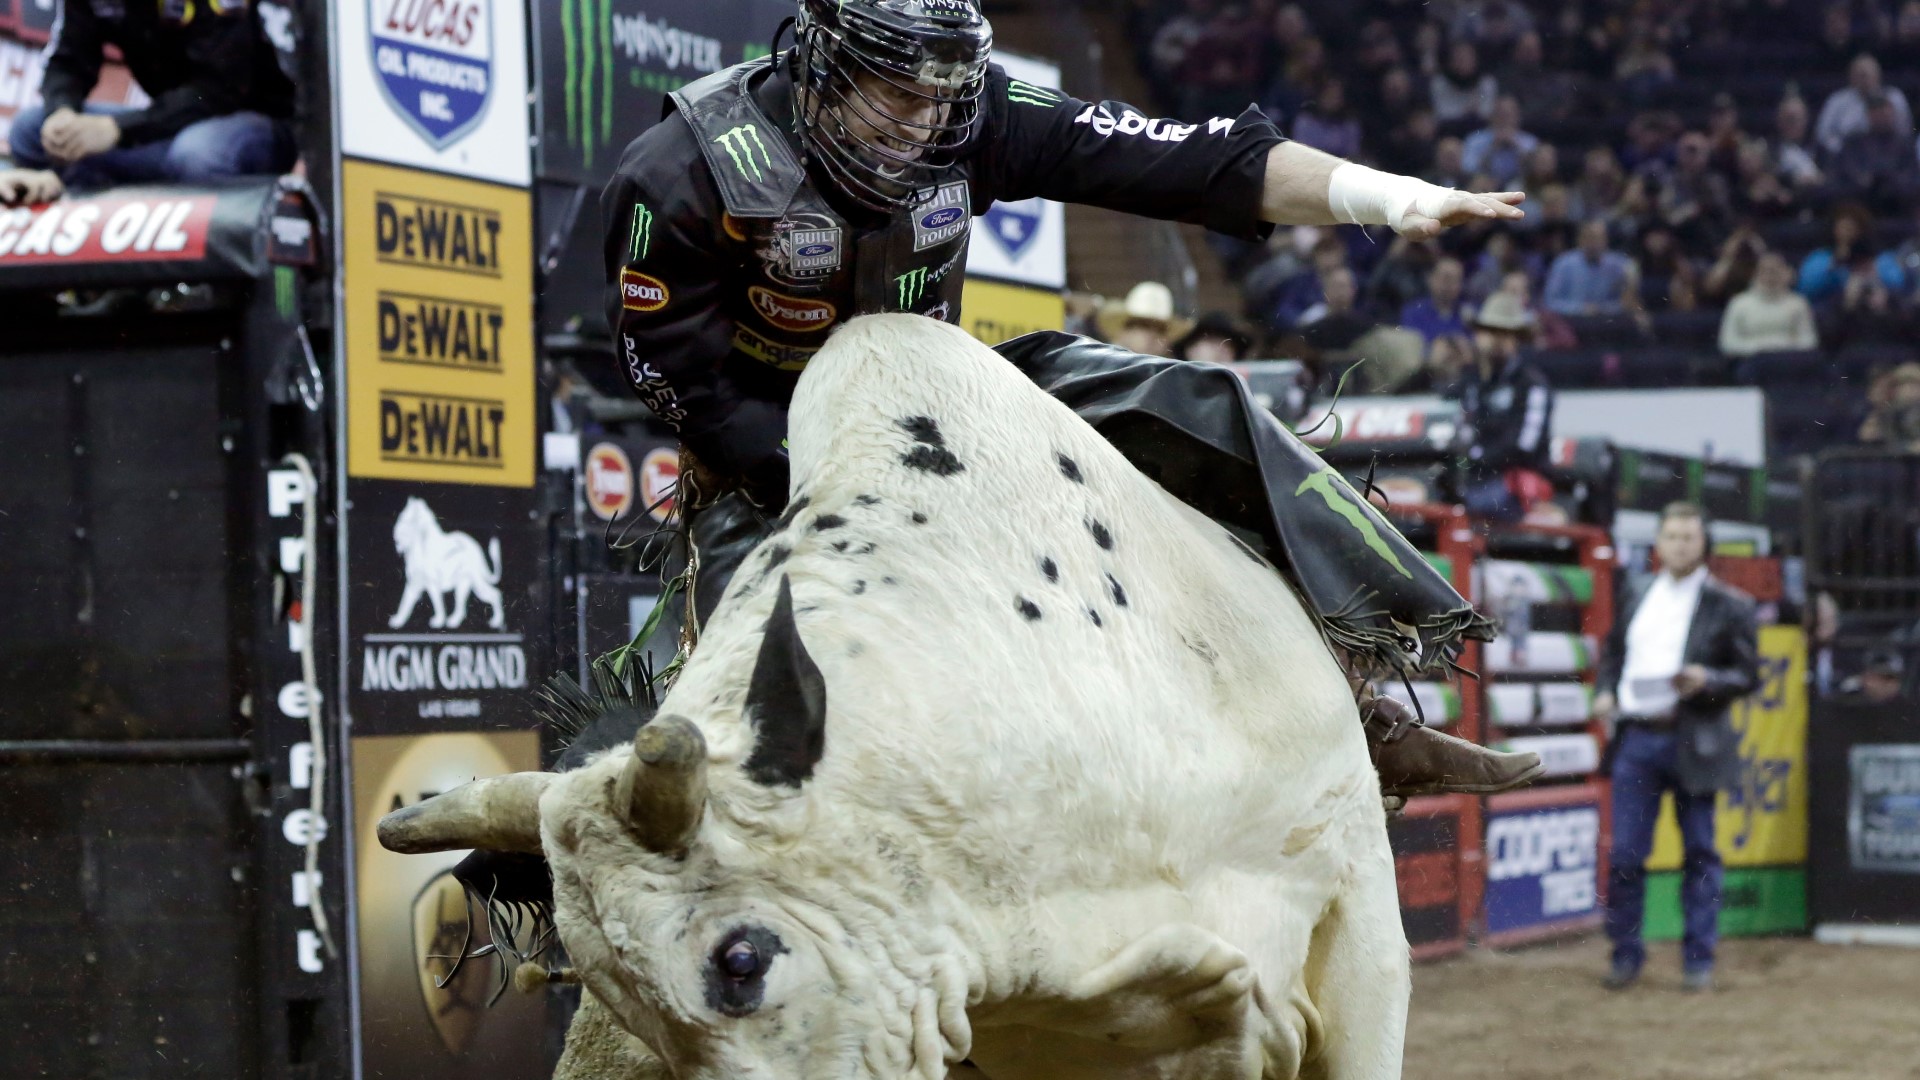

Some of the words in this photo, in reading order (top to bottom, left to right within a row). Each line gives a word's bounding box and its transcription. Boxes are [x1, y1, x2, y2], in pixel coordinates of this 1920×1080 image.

[377, 45, 406, 77] OIL
[406, 51, 488, 95] PRODUCTS
[102, 202, 192, 253] OIL
[794, 230, 837, 244] BUILT
[920, 220, 966, 246] TOUGH
[796, 255, 837, 267] TOUGH
[760, 291, 829, 321] Tyson
[362, 645, 436, 691] MGM
[437, 645, 527, 690] GRAND
[1487, 808, 1599, 880] COOPER
